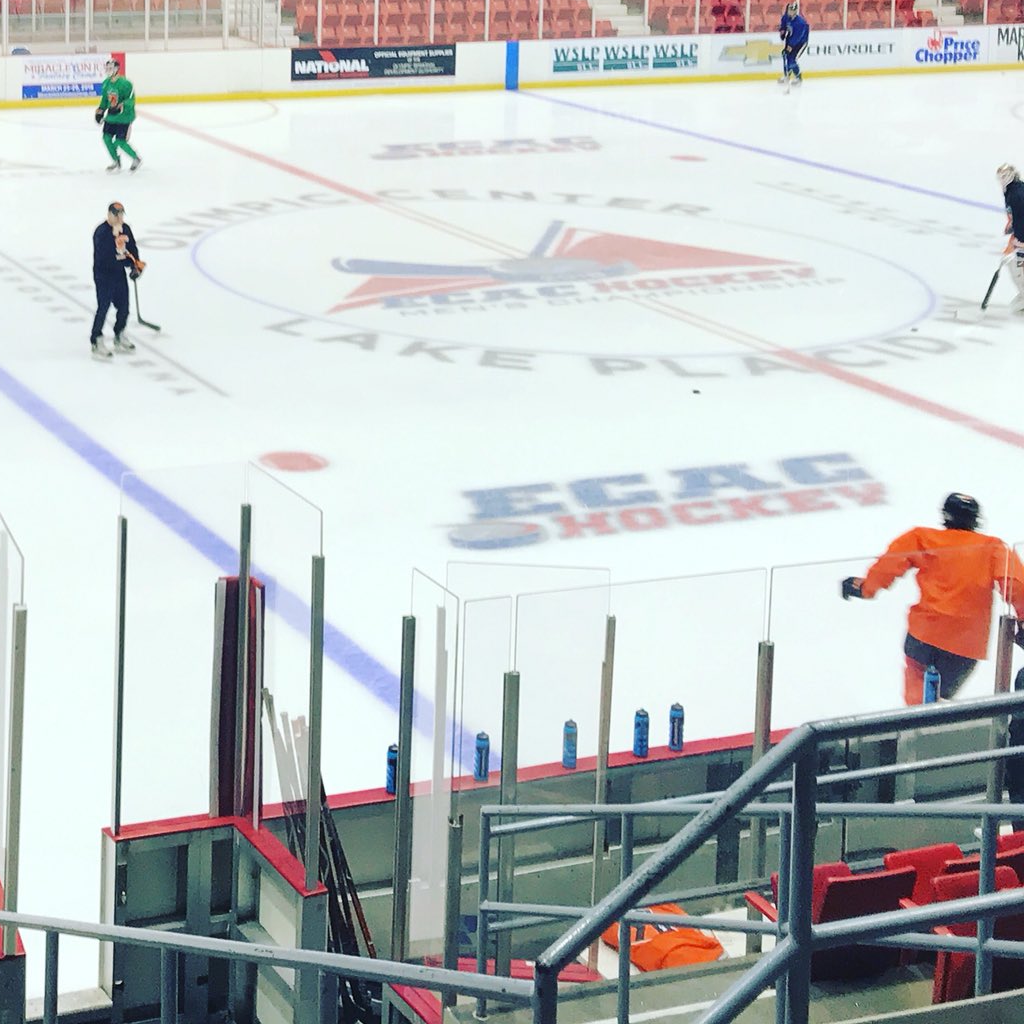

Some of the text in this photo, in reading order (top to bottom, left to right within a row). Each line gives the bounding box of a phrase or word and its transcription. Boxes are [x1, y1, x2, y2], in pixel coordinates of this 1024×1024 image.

[603, 45, 649, 61] WSLP
[653, 43, 698, 59] WSLP
[807, 43, 895, 56] CHEVROLET
[944, 37, 980, 52] Price
[553, 46, 600, 62] WSLP
[915, 48, 978, 64] Chopper
[294, 58, 370, 75] NATIONAL
[375, 187, 713, 219] CENTER
[382, 266, 816, 310] ECAC HOCKEY
[399, 277, 847, 318] MEN'S CHAMPIONSHIP
[265, 318, 536, 372] LAKE
[463, 451, 873, 519] ECAC
[557, 482, 888, 540] HOCKEY
